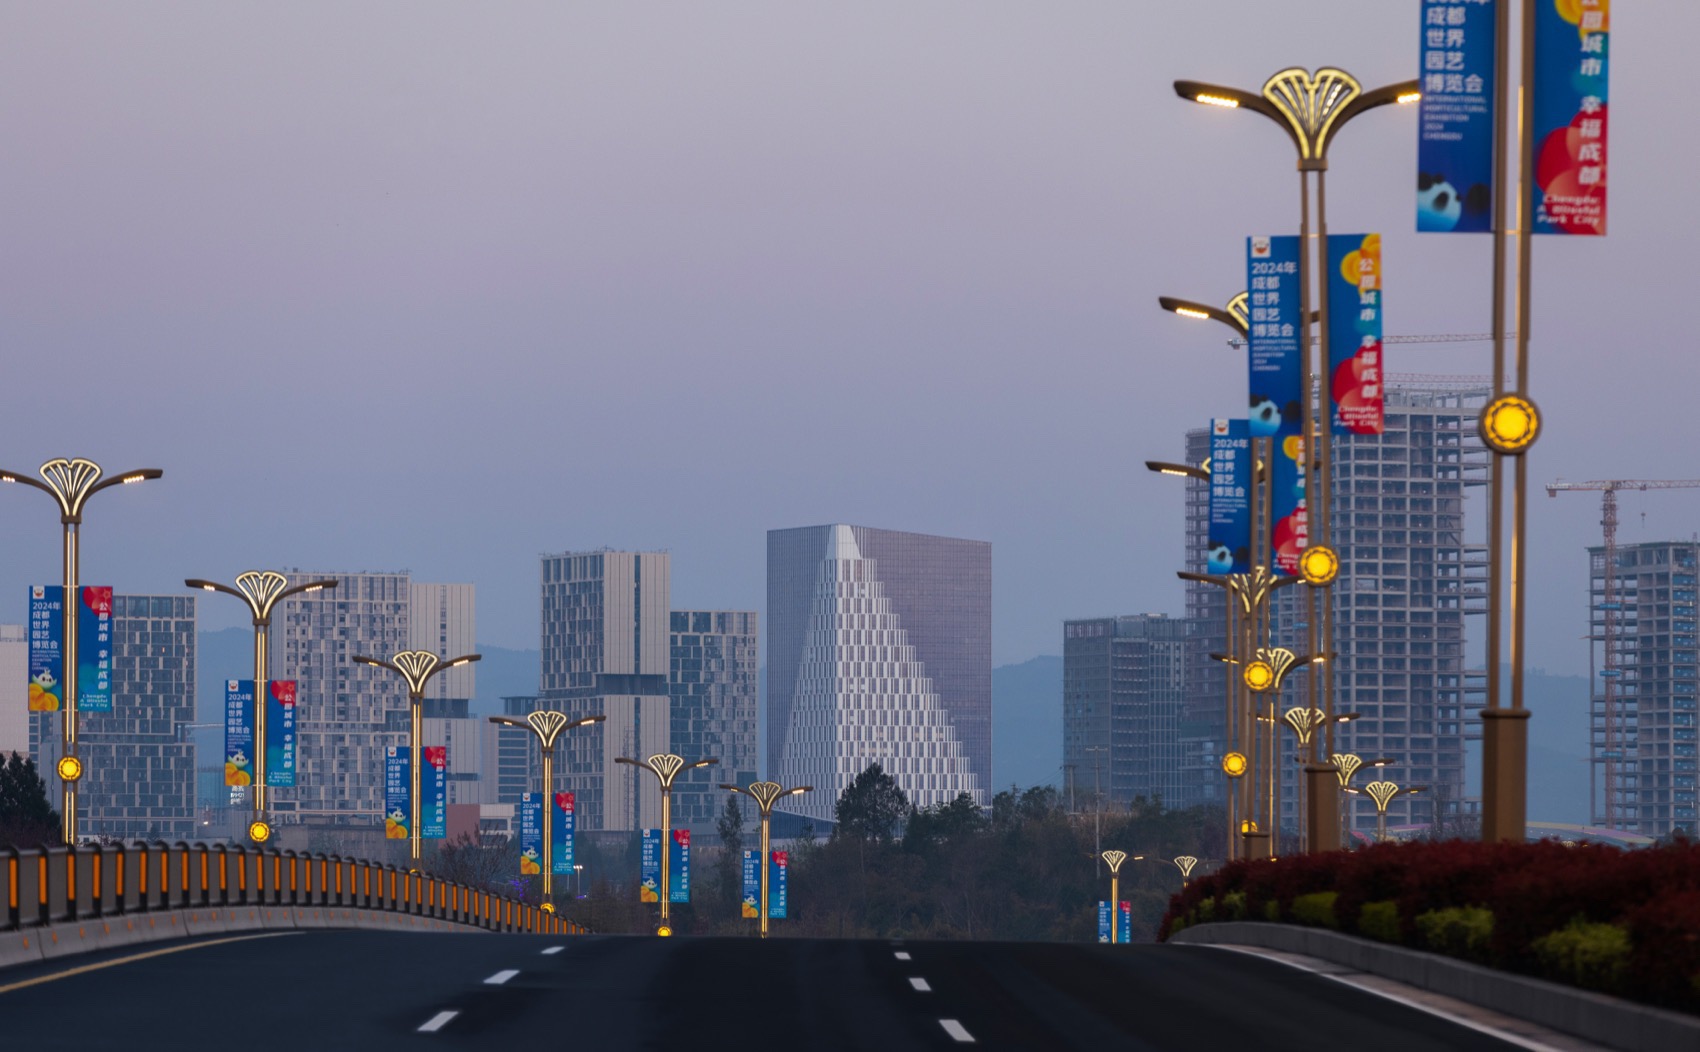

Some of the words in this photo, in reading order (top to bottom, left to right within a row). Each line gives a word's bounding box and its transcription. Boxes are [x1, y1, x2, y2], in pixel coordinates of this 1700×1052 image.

[1427, 7, 1466, 26] 成都
[1426, 29, 1465, 49] 世界
[1425, 51, 1464, 71] 园艺
[1425, 74, 1483, 93] 博览会
[1252, 261, 1297, 274] 2024年
[1252, 276, 1280, 289] 成都
[1359, 258, 1376, 321] 公园城市
[1252, 292, 1280, 305] 世界
[1252, 308, 1280, 321] 园艺
[1253, 323, 1294, 337] 博览会
[1361, 335, 1377, 398] 幸福成都
[1213, 438, 1248, 448] 2024年
[1213, 450, 1235, 460] 成都
[1213, 462, 1235, 472] 世界
[1213, 474, 1235, 485] 园艺
[1213, 486, 1245, 497] 博览会
[32, 602, 61, 610] 2024年
[32, 611, 50, 620] 成都
[98, 602, 108, 642] 公园城市
[32, 620, 50, 629] 世界
[32, 630, 50, 639] 园艺
[32, 640, 58, 649] 博览会
[98, 650, 108, 690] 幸福成都
